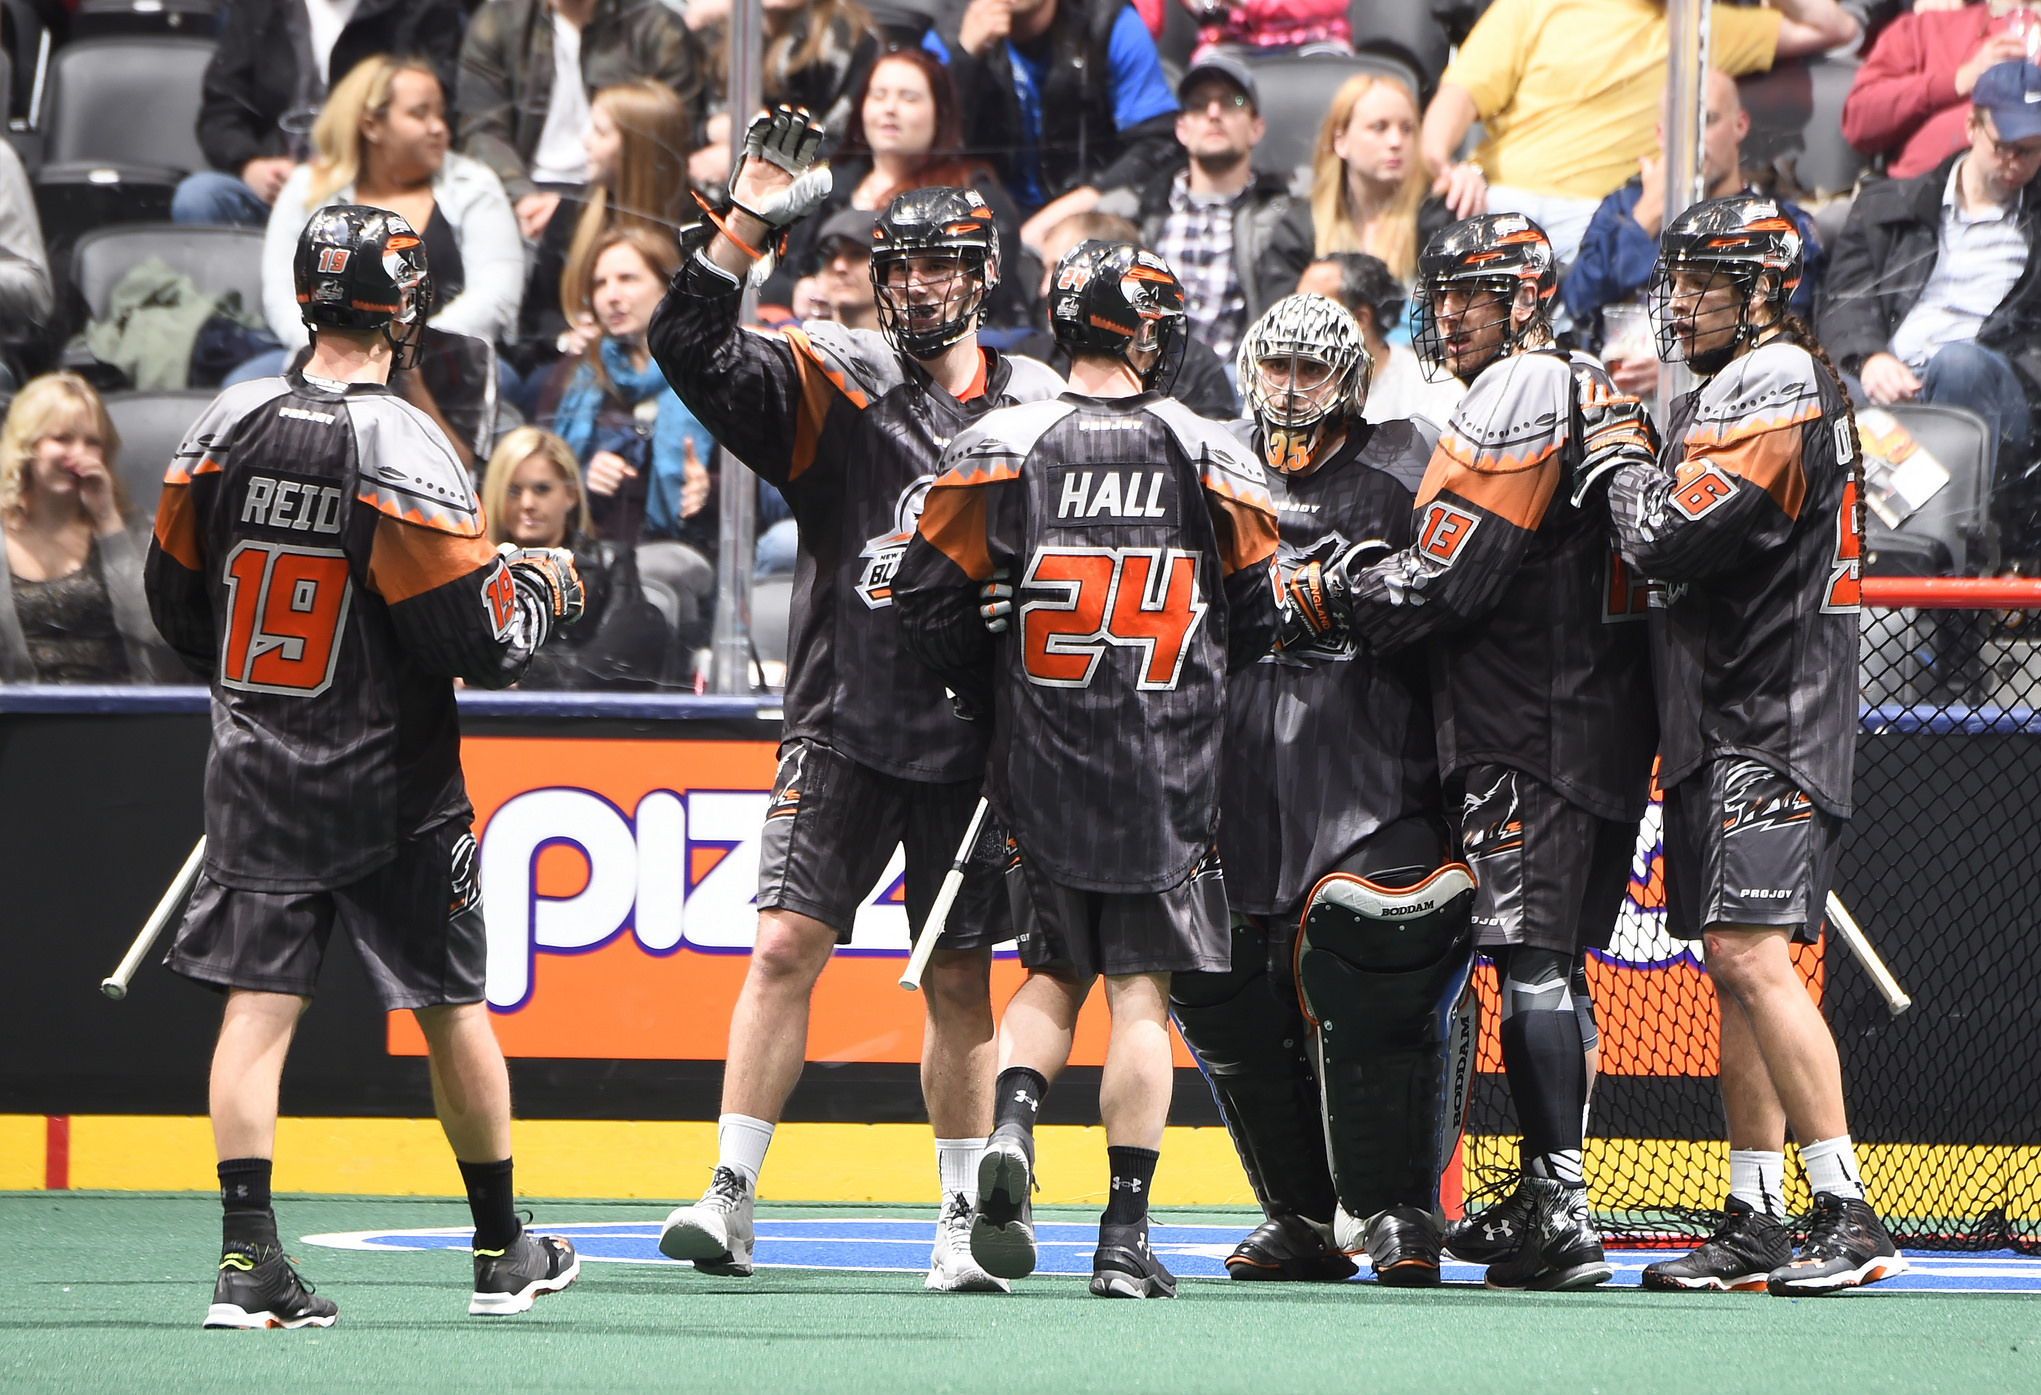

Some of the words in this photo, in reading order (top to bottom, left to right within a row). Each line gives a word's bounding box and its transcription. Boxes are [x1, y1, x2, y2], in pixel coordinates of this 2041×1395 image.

[316, 246, 352, 274] 19
[1058, 266, 1093, 293] 24
[1267, 432, 1308, 472] 35
[240, 476, 342, 535] REID
[1057, 472, 1166, 519] HALL
[1418, 500, 1482, 567] 13
[221, 539, 353, 698] 19
[481, 558, 516, 640] 19
[1020, 546, 1209, 691] 24
[1309, 580, 1331, 630] ENGLAND
[1381, 900, 1435, 917] BODDAM
[1740, 889, 1793, 899] PROJOY
[1453, 1015, 1470, 1129] BODDAM
